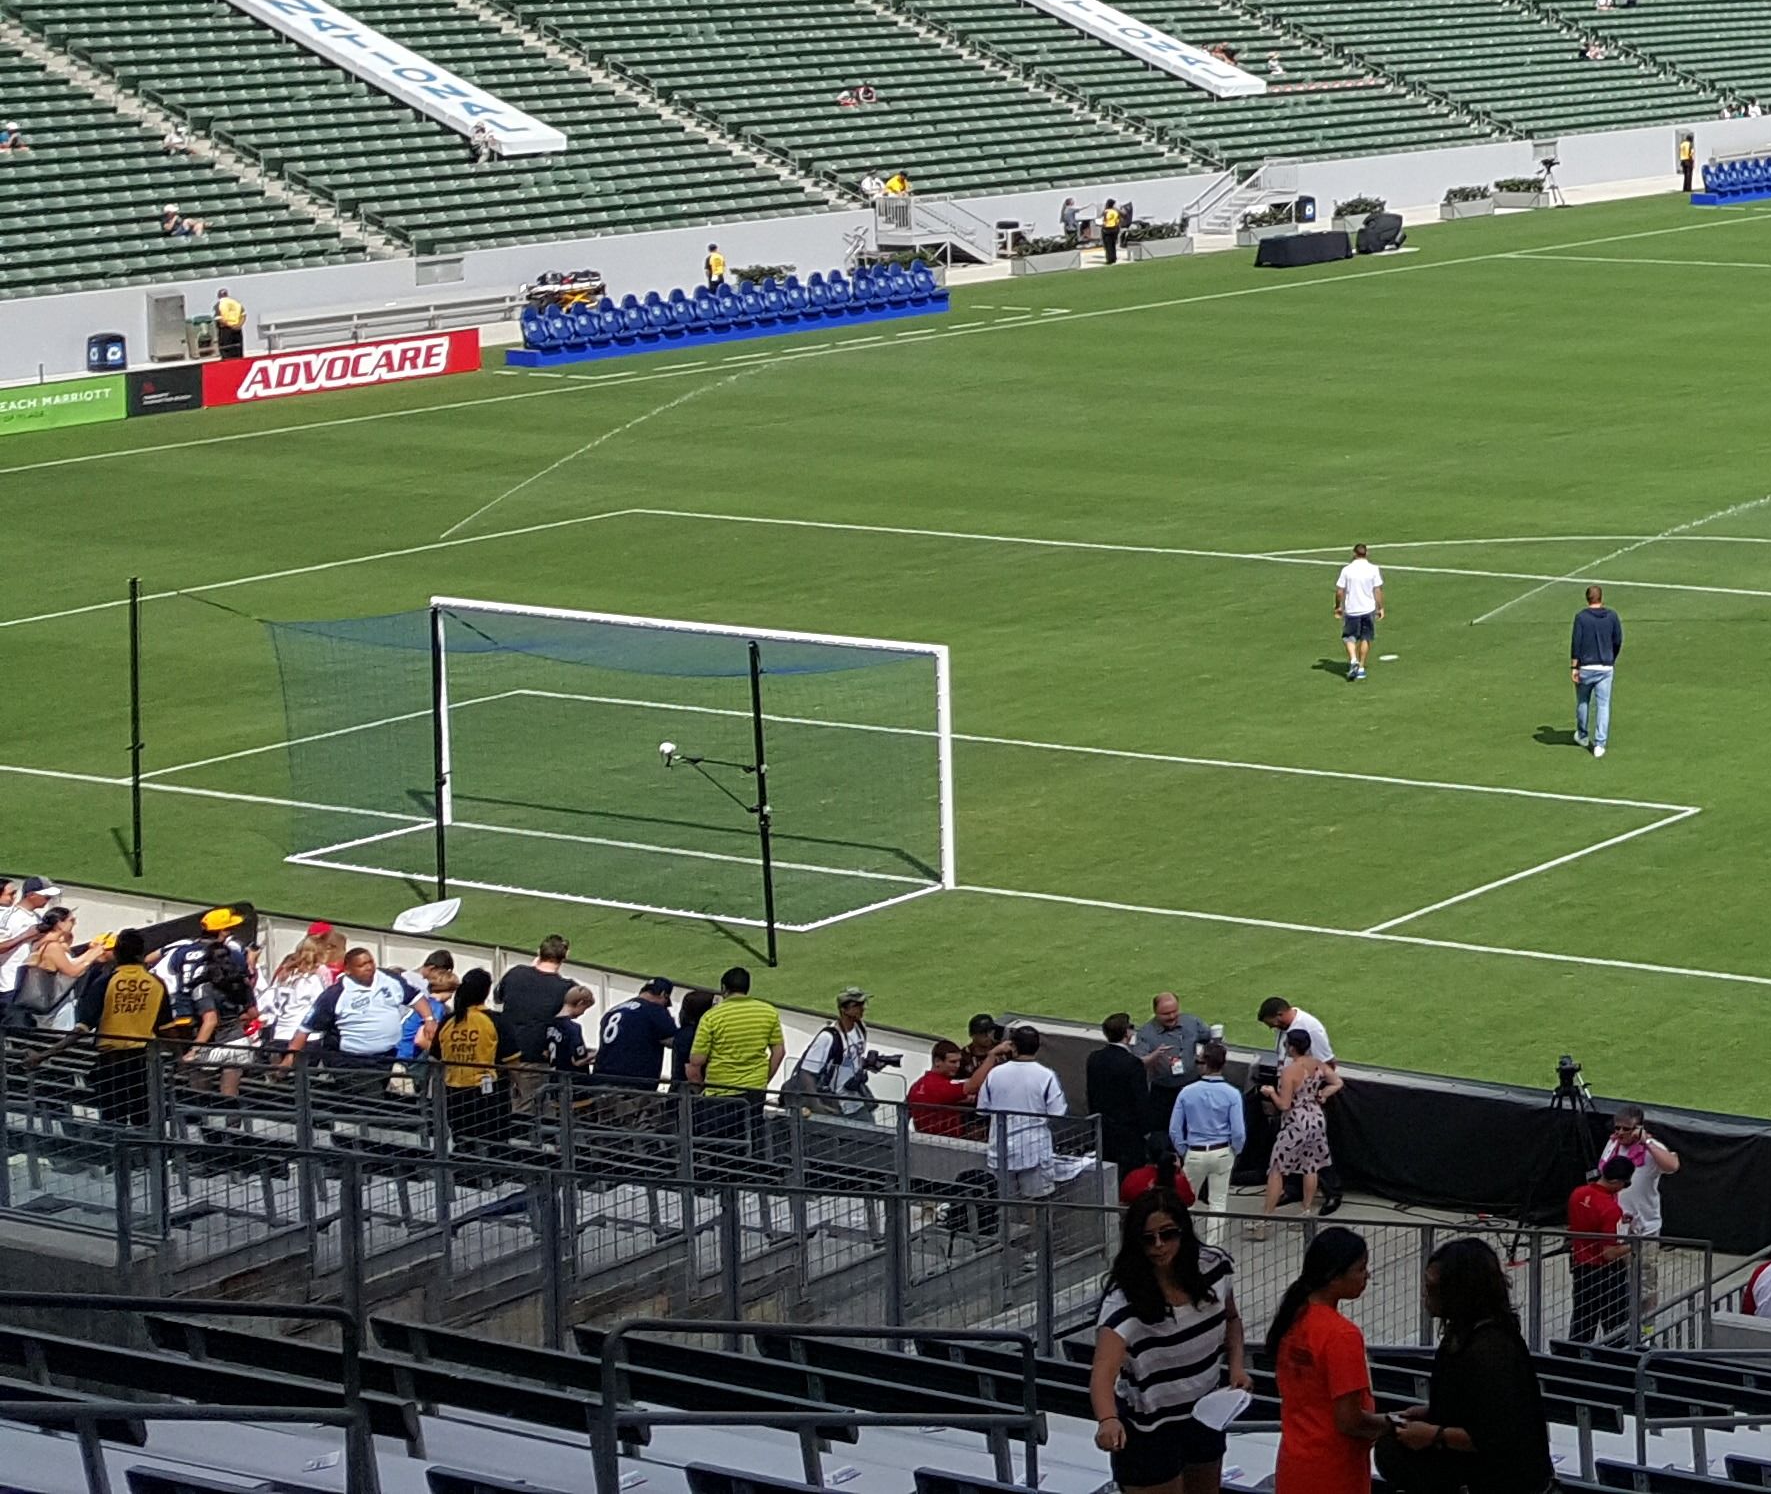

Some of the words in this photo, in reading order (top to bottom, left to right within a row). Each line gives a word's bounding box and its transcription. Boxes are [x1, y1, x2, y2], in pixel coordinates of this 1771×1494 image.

[240, 339, 447, 395] ADVOCARE
[43, 388, 112, 406] MARRIOTT
[116, 979, 151, 992] CSC
[114, 993, 149, 1003] EVENT
[113, 1004, 147, 1014] STAFF
[603, 1013, 622, 1044] 8
[451, 1029, 479, 1042] CSC
